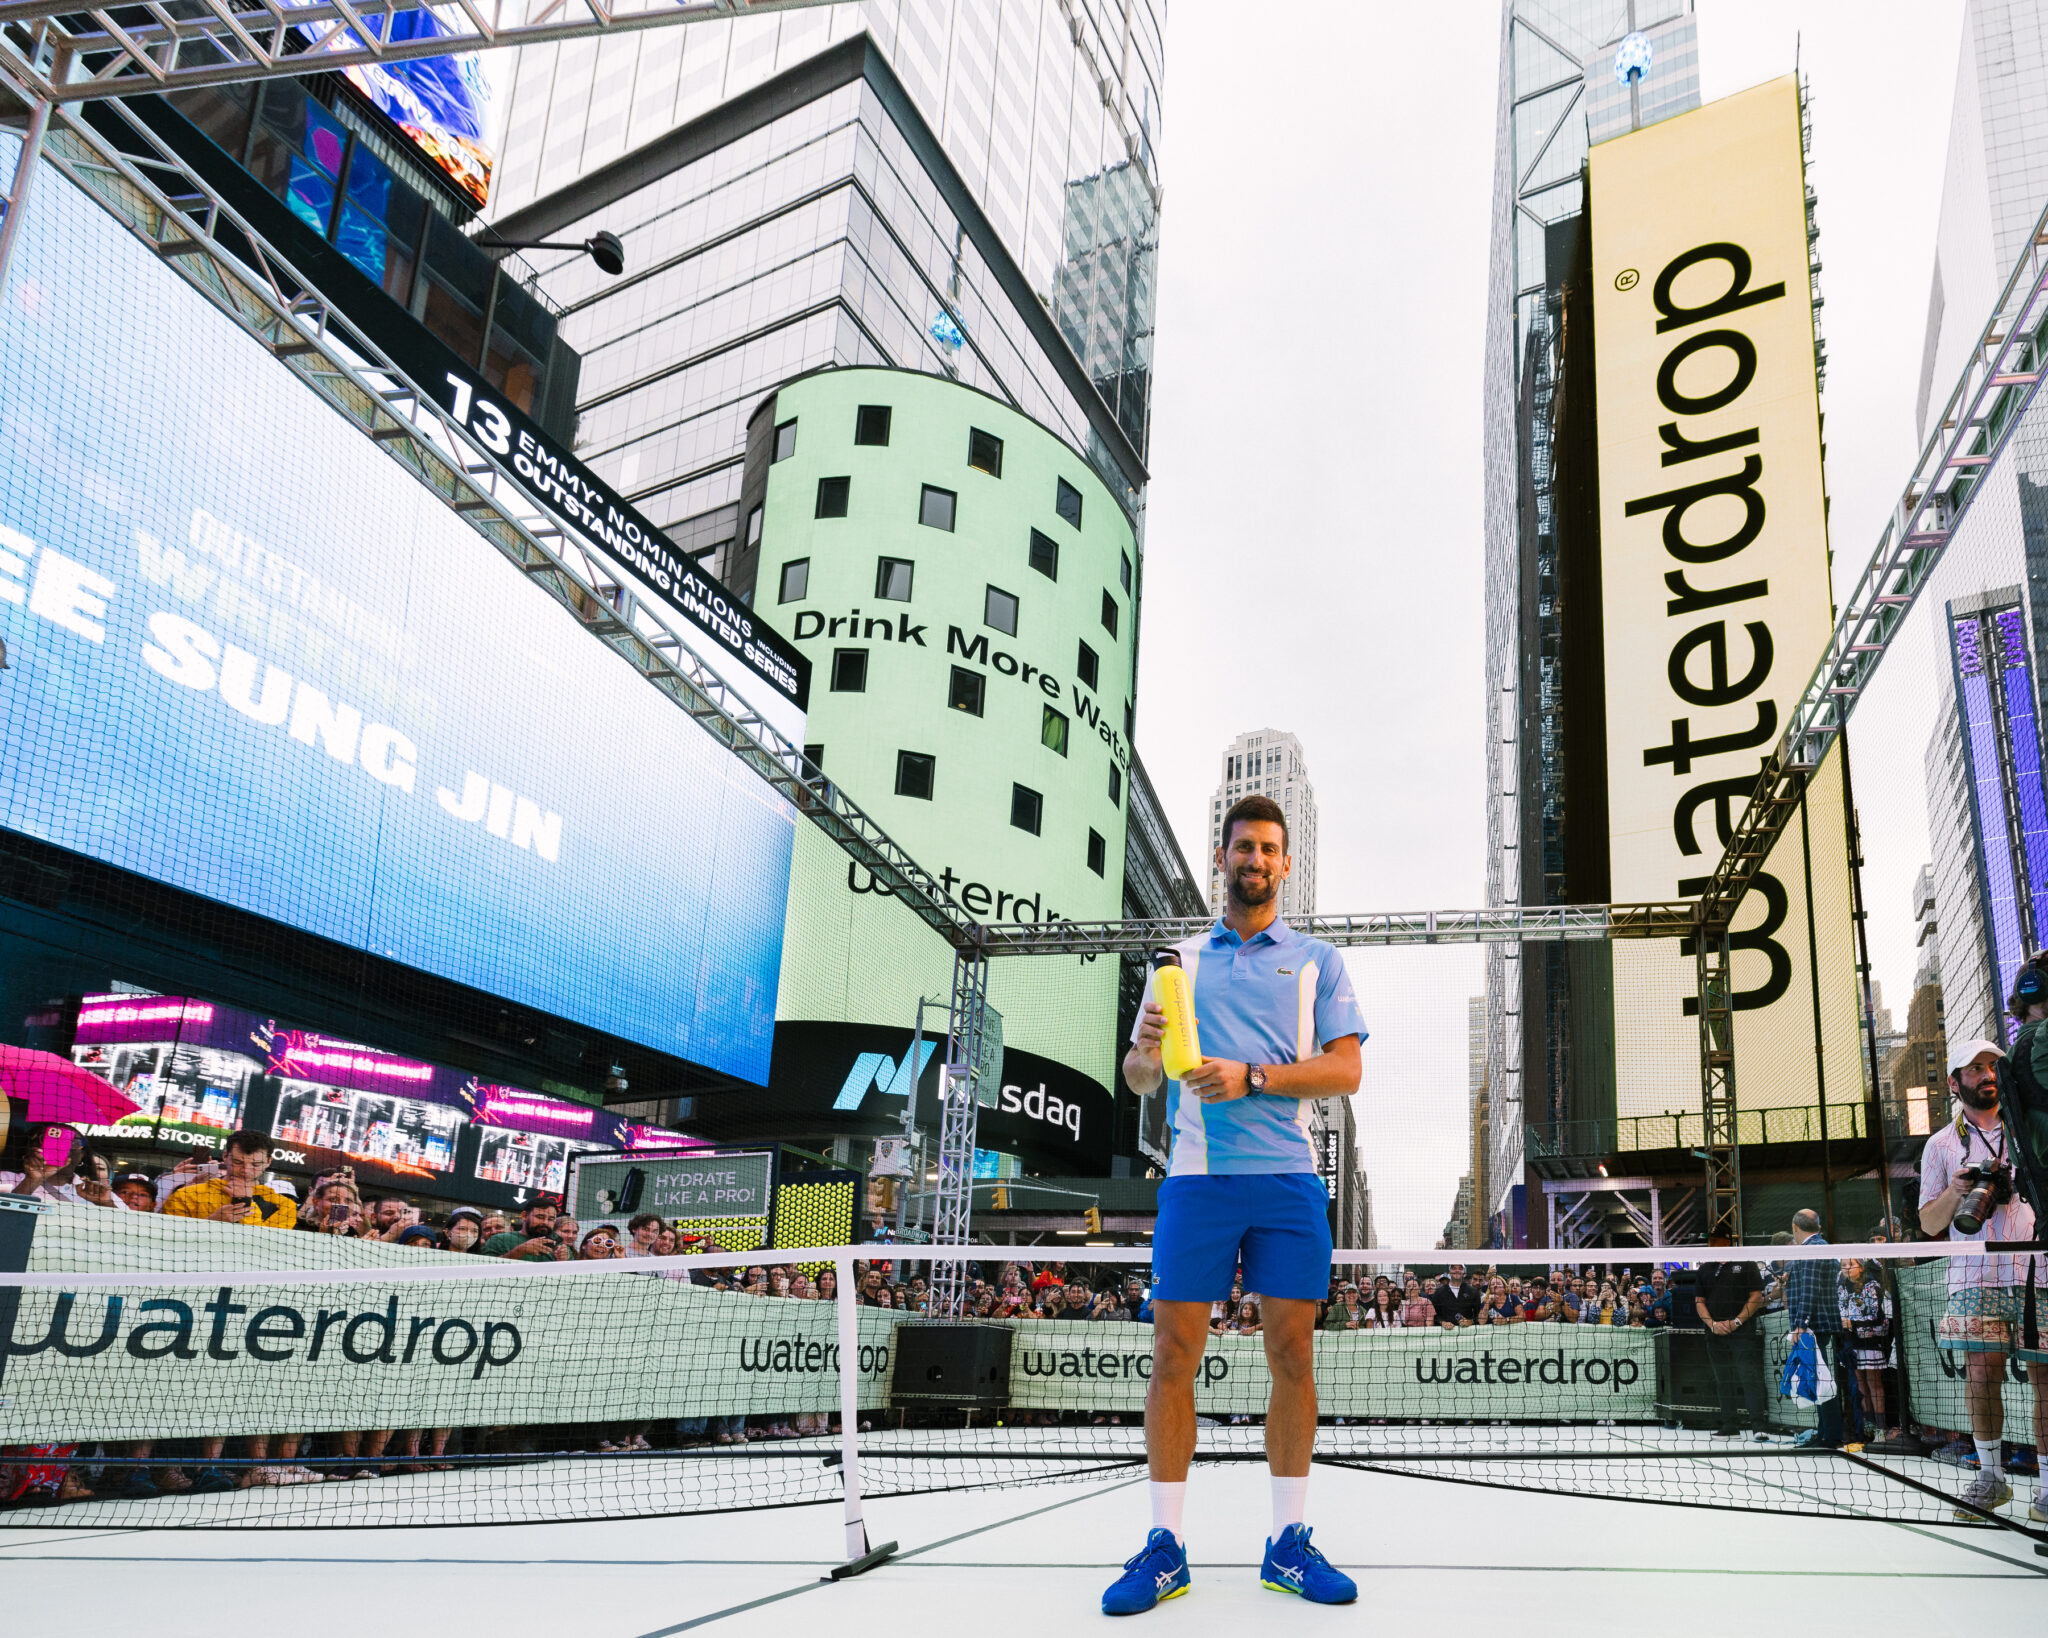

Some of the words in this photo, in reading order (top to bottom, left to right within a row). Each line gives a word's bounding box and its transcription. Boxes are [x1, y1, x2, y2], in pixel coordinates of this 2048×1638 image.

[446, 372, 512, 455] 13
[608, 505, 752, 637] NOMINATIONS
[757, 638, 798, 677] INCLUDING
[513, 453, 671, 590] OUTSTANDING
[673, 582, 743, 649] LIMITED
[743, 642, 798, 695] SERIES
[793, 608, 928, 647] Drink
[946, 624, 1061, 700] More
[141, 610, 418, 794] SUNG
[437, 770, 563, 863] JIN
[1173, 978, 1192, 1047] waterdrop
[157, 1127, 217, 1149] STORE
[272, 1148, 307, 1166] ORK
[654, 1190, 692, 1206] LIKE
[696, 1190, 710, 1204] A
[714, 1187, 756, 1204] PRO!
[655, 1171, 737, 1189] HYDRATE
[896, 1227, 927, 1242] BROADWAY
[740, 1332, 889, 1382] waterop
